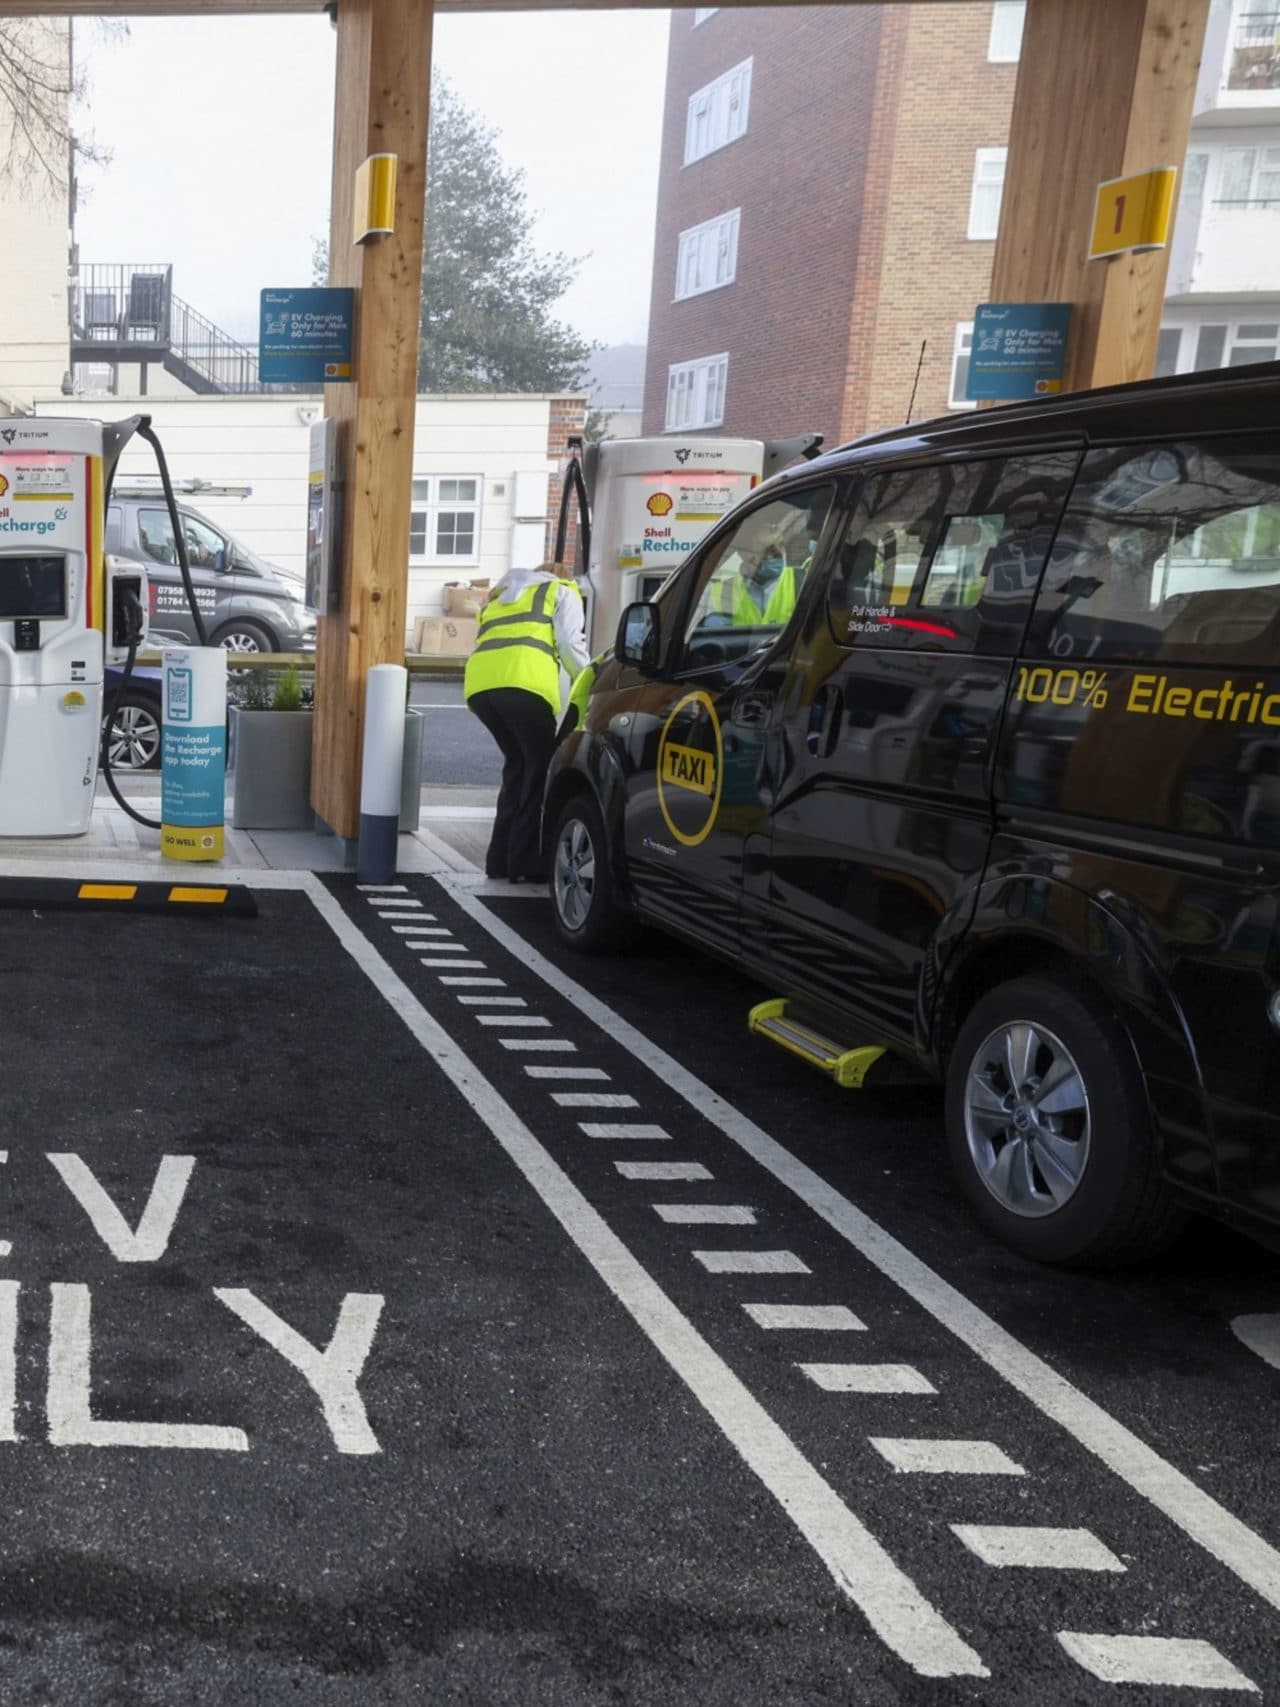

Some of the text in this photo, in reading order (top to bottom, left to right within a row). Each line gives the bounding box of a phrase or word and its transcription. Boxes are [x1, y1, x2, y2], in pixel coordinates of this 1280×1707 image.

[1113, 195, 1126, 235] 1
[291, 313, 343, 322] EV Charging
[291, 321, 312, 330] Only
[314, 321, 326, 329] for
[291, 330, 337, 338] 60 minutes
[1006, 329, 1059, 338] EV Charging
[1005, 338, 1025, 347] Only
[1003, 346, 1015, 354] 60
[644, 527, 671, 538] Shell
[643, 538, 697, 552] Rechar
[851, 605, 865, 616] Pull
[865, 605, 889, 617] Handle
[864, 621, 882, 633] Door
[1017, 667, 1280, 726] 100% Electric
[165, 732, 209, 744] Download
[165, 743, 222, 756] the Recharge
[165, 756, 210, 768] app today
[669, 751, 707, 786] TAXI
[176, 839, 196, 847] WELL
